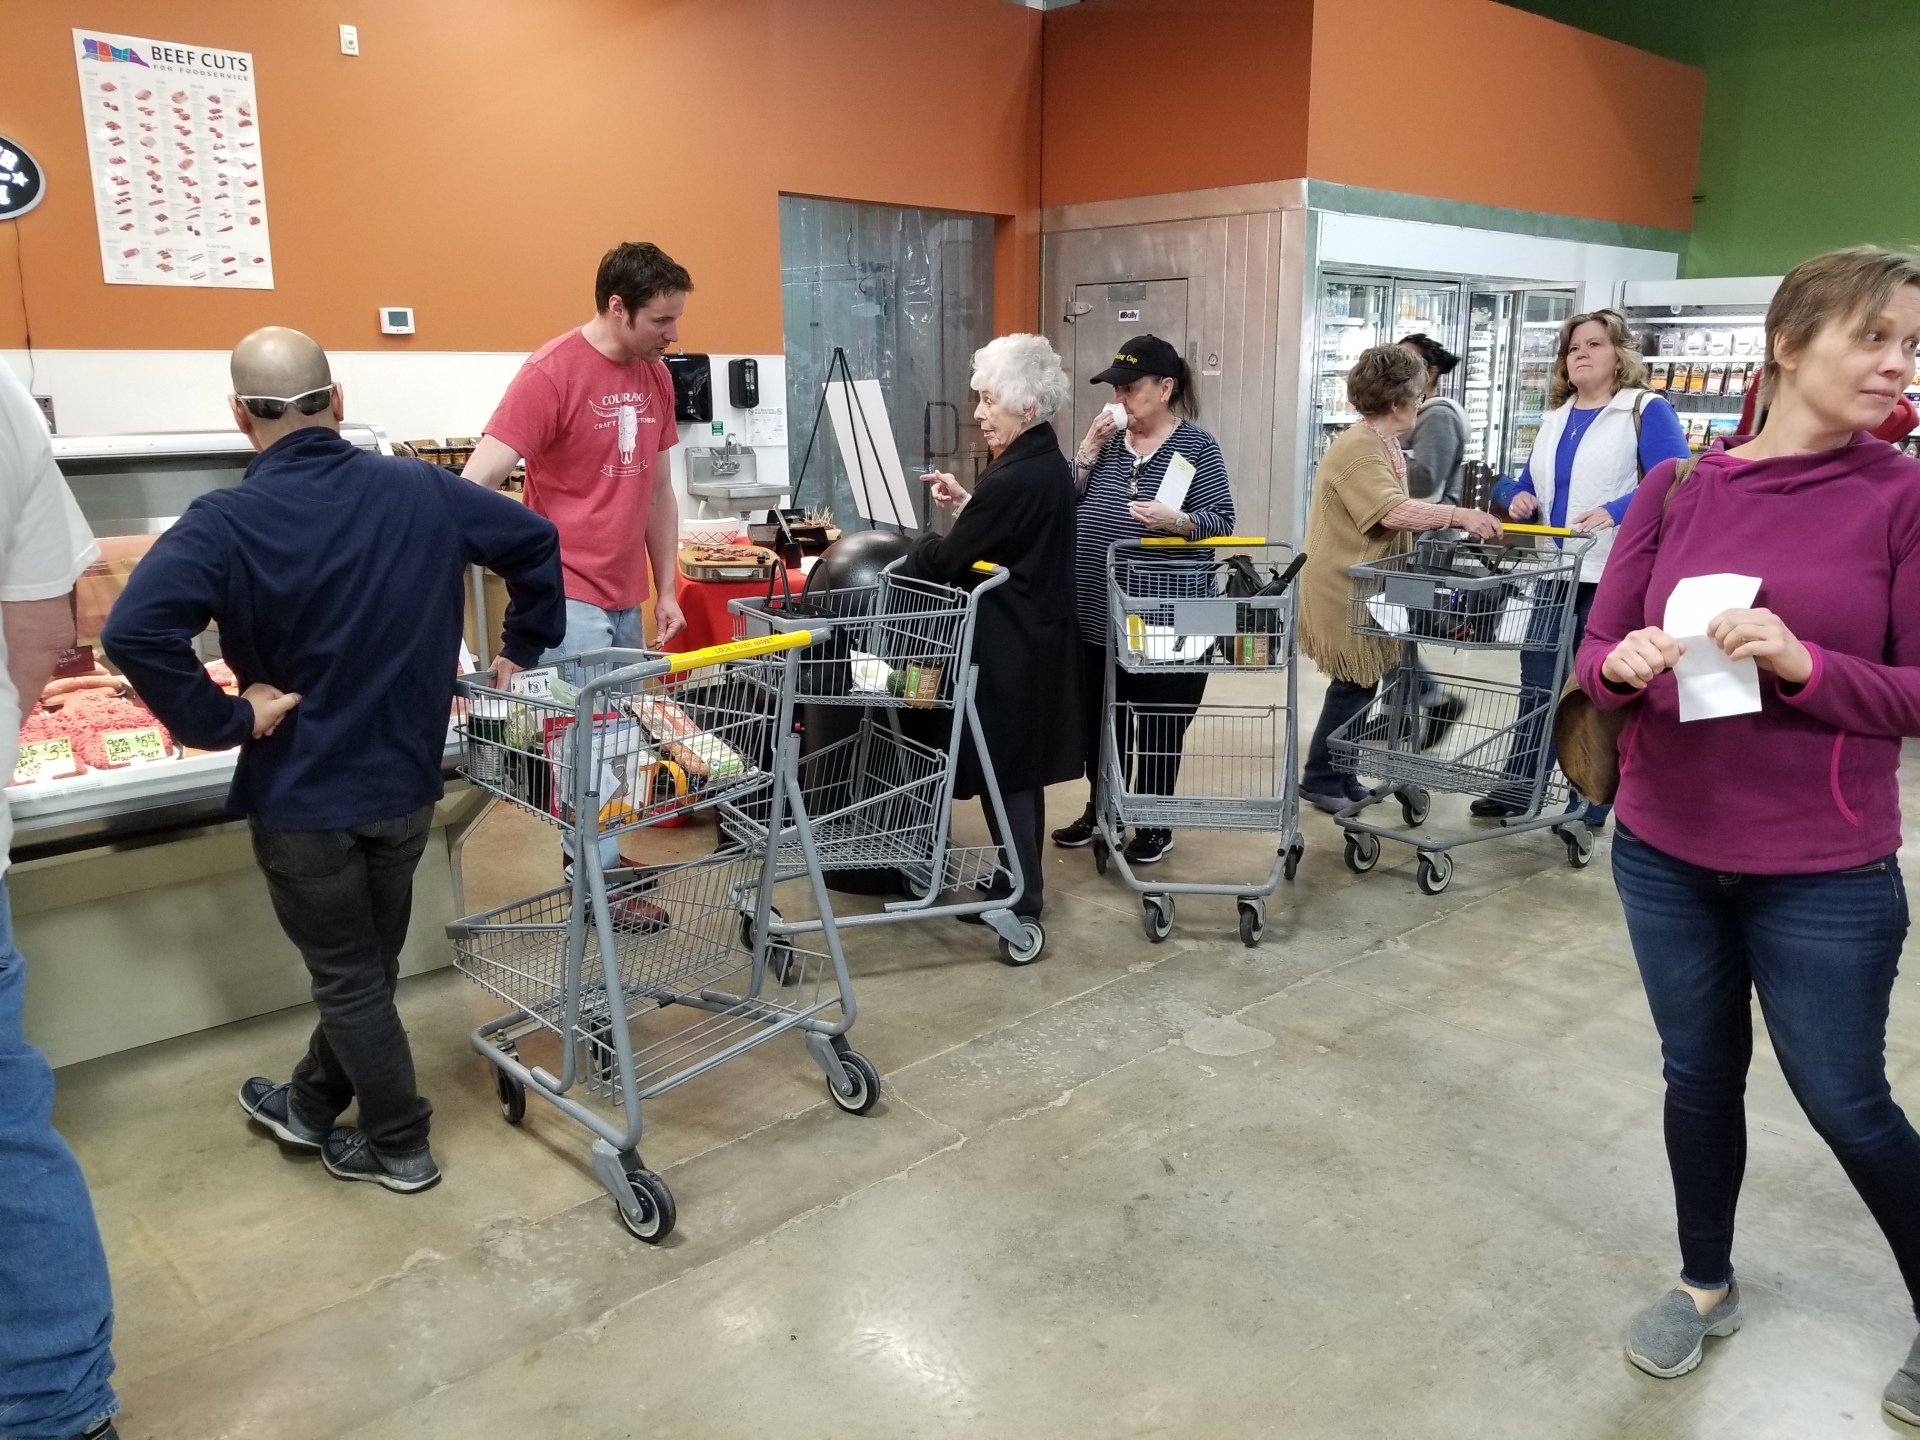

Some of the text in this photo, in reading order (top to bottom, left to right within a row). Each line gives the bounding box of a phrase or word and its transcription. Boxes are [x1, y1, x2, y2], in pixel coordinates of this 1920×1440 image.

[151, 45, 249, 72] BEEF CUTS
[153, 64, 249, 82] FOR FOODSERVICE
[594, 420, 617, 430] CRAFT
[525, 670, 549, 679] WARNING
